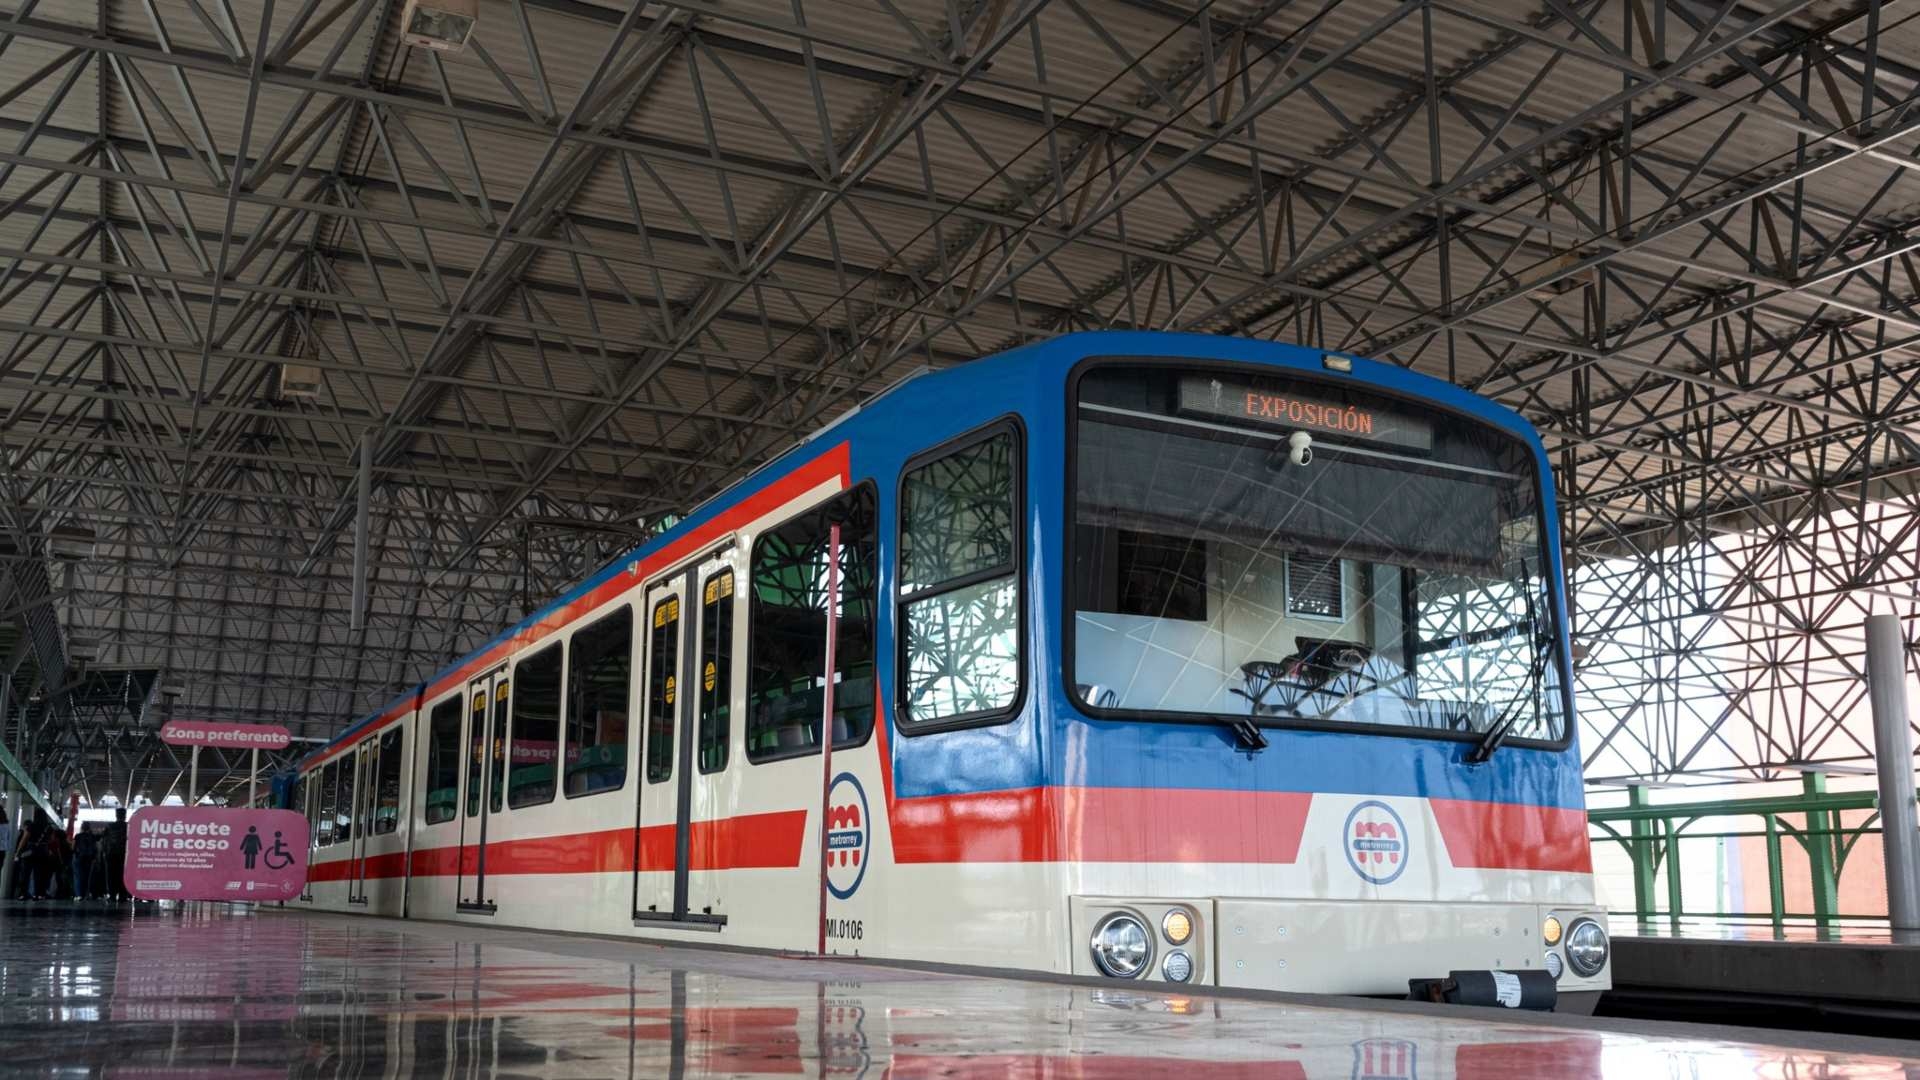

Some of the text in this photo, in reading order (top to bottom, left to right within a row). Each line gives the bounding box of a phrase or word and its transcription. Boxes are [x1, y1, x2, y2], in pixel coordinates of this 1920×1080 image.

[1247, 393, 1373, 433] EXPOSICIÓN
[165, 727, 289, 743] Zona preferente
[140, 819, 231, 836] Muévete
[140, 833, 230, 850] sin acoso
